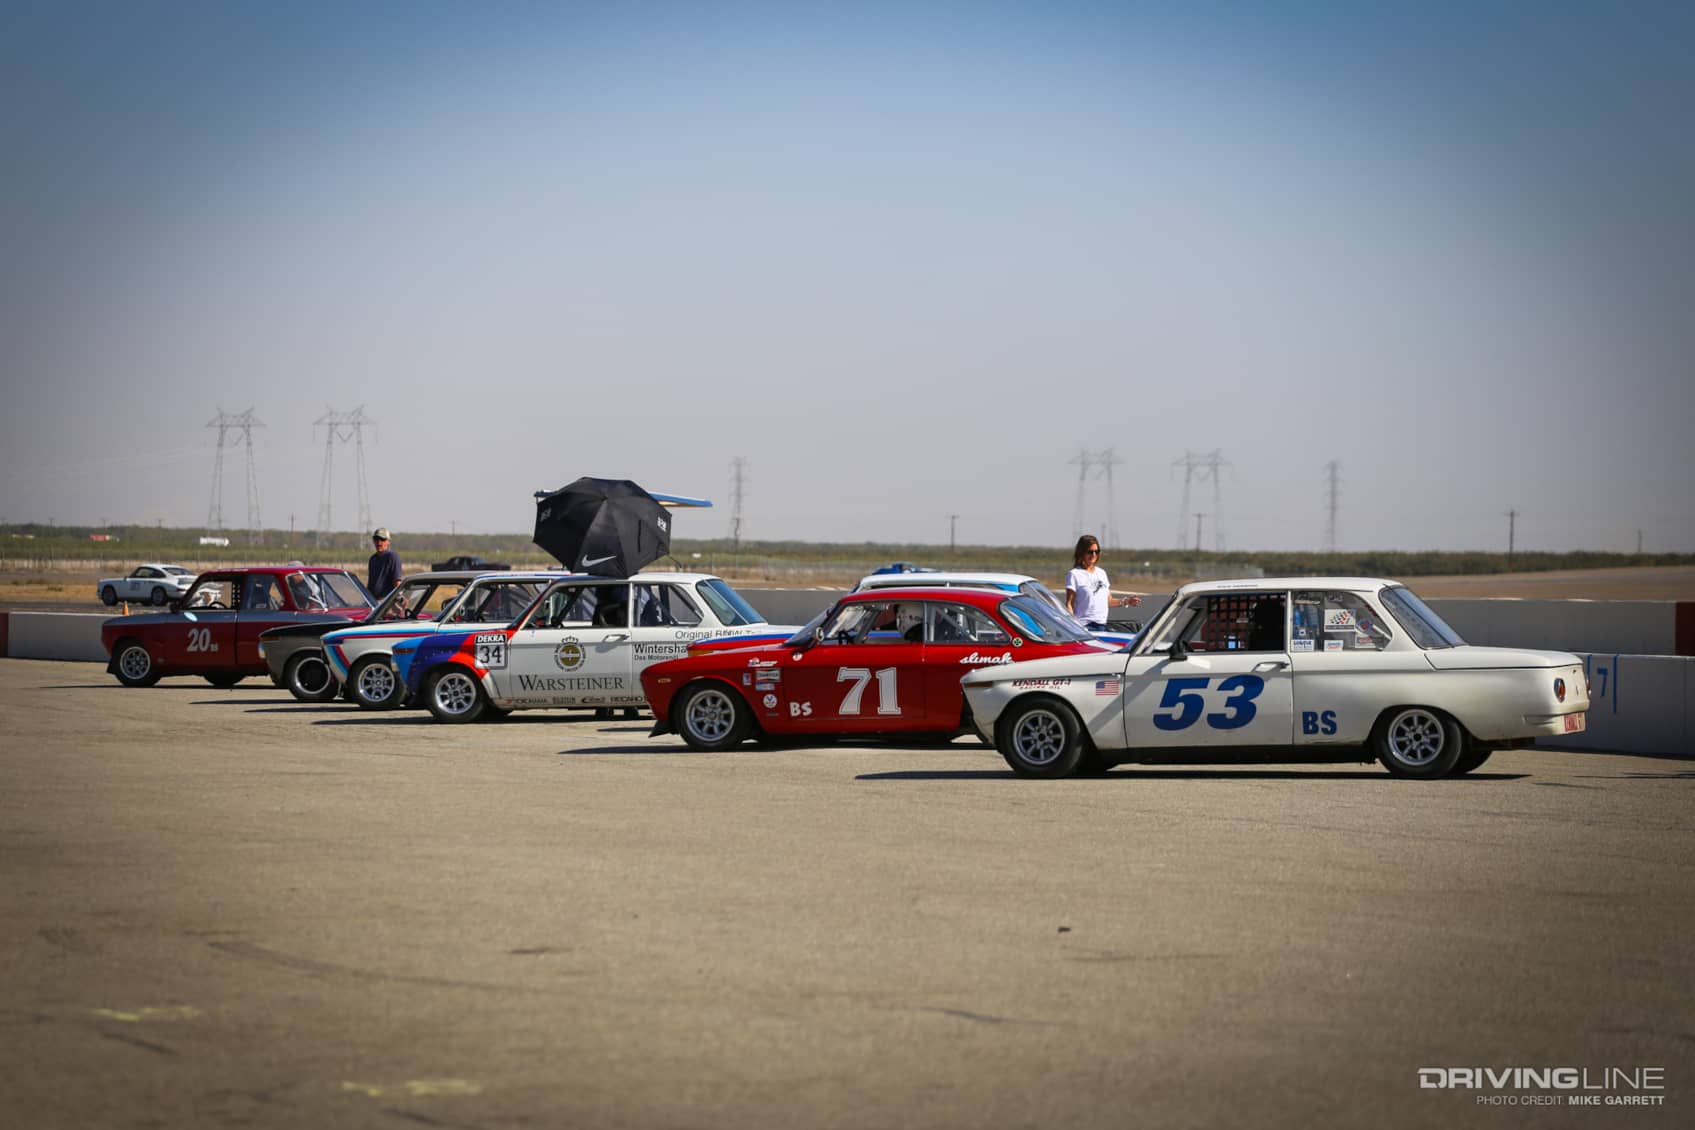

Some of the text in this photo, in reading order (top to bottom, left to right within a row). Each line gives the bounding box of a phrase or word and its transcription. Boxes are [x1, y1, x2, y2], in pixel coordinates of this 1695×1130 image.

[187, 628, 210, 651] 20
[477, 635, 505, 643] DEKRA
[675, 630, 712, 641] Original
[479, 645, 502, 664] 34
[634, 643, 688, 653] Wintersha
[518, 674, 625, 692] WARSTEINER
[837, 667, 901, 715] 71
[789, 701, 812, 716] BS
[1153, 674, 1264, 731] 53
[1302, 710, 1338, 735] BS
